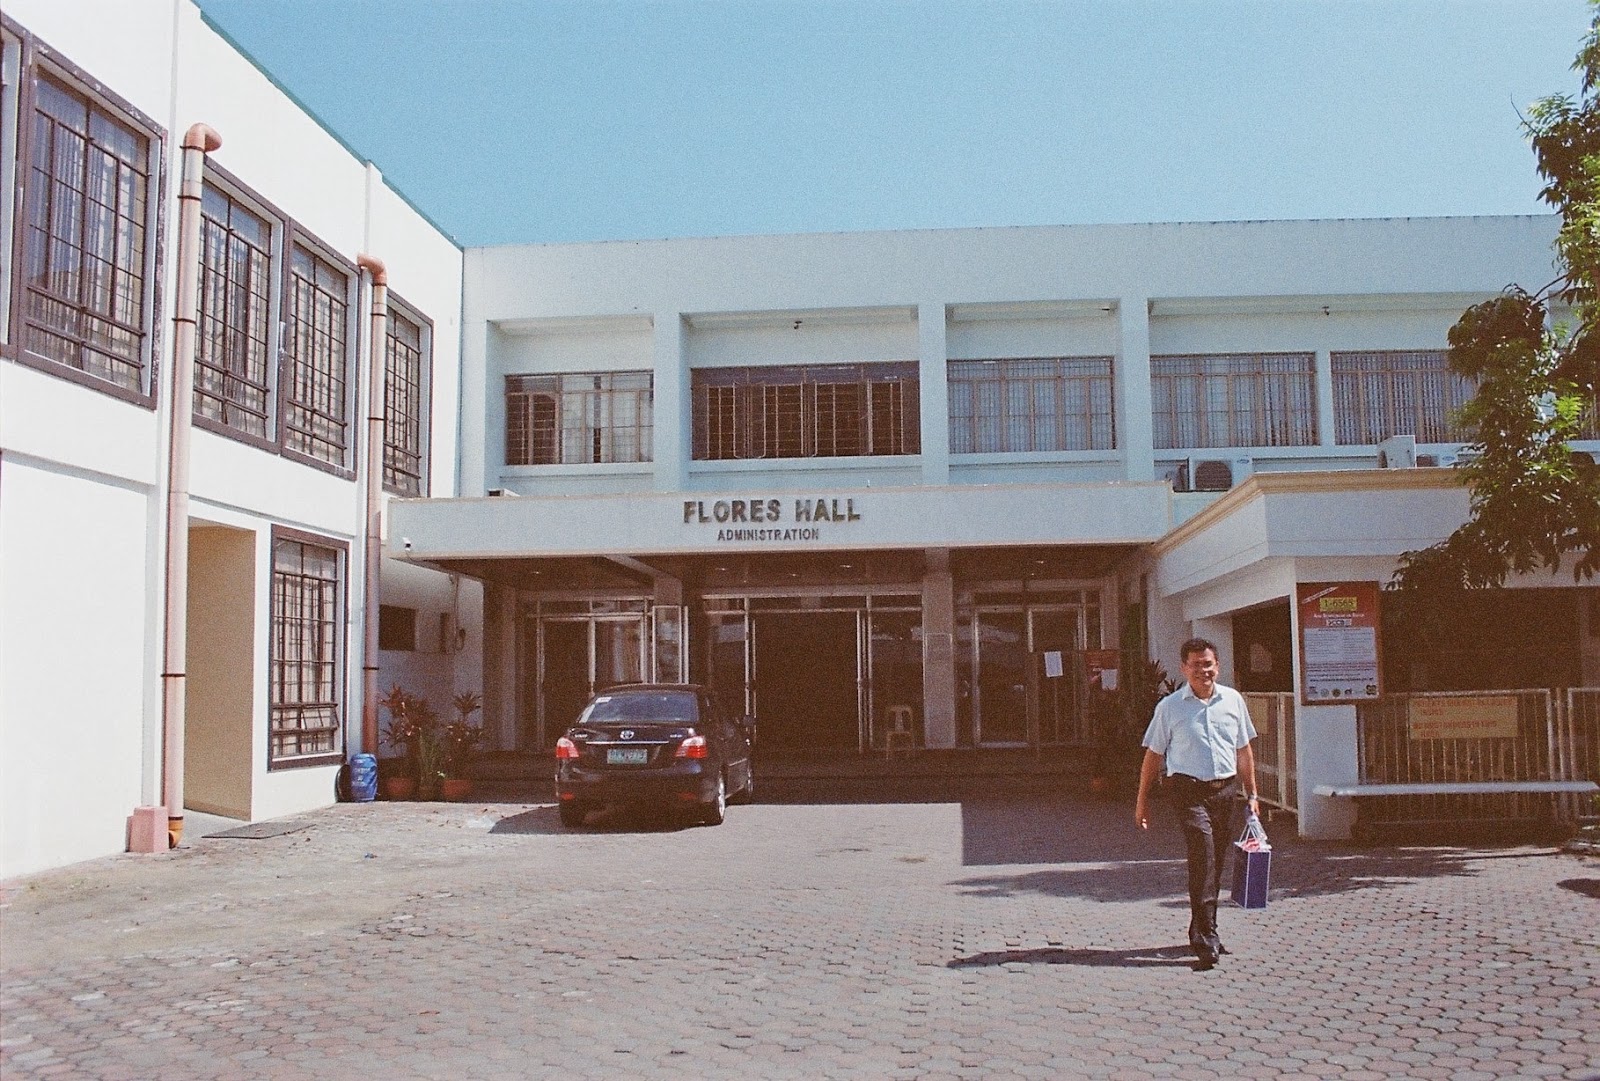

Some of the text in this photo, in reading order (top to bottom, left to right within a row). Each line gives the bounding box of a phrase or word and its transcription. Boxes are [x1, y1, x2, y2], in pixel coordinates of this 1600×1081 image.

[683, 498, 861, 524] FLORES HALL
[717, 528, 819, 541] ADMINISTRATION
